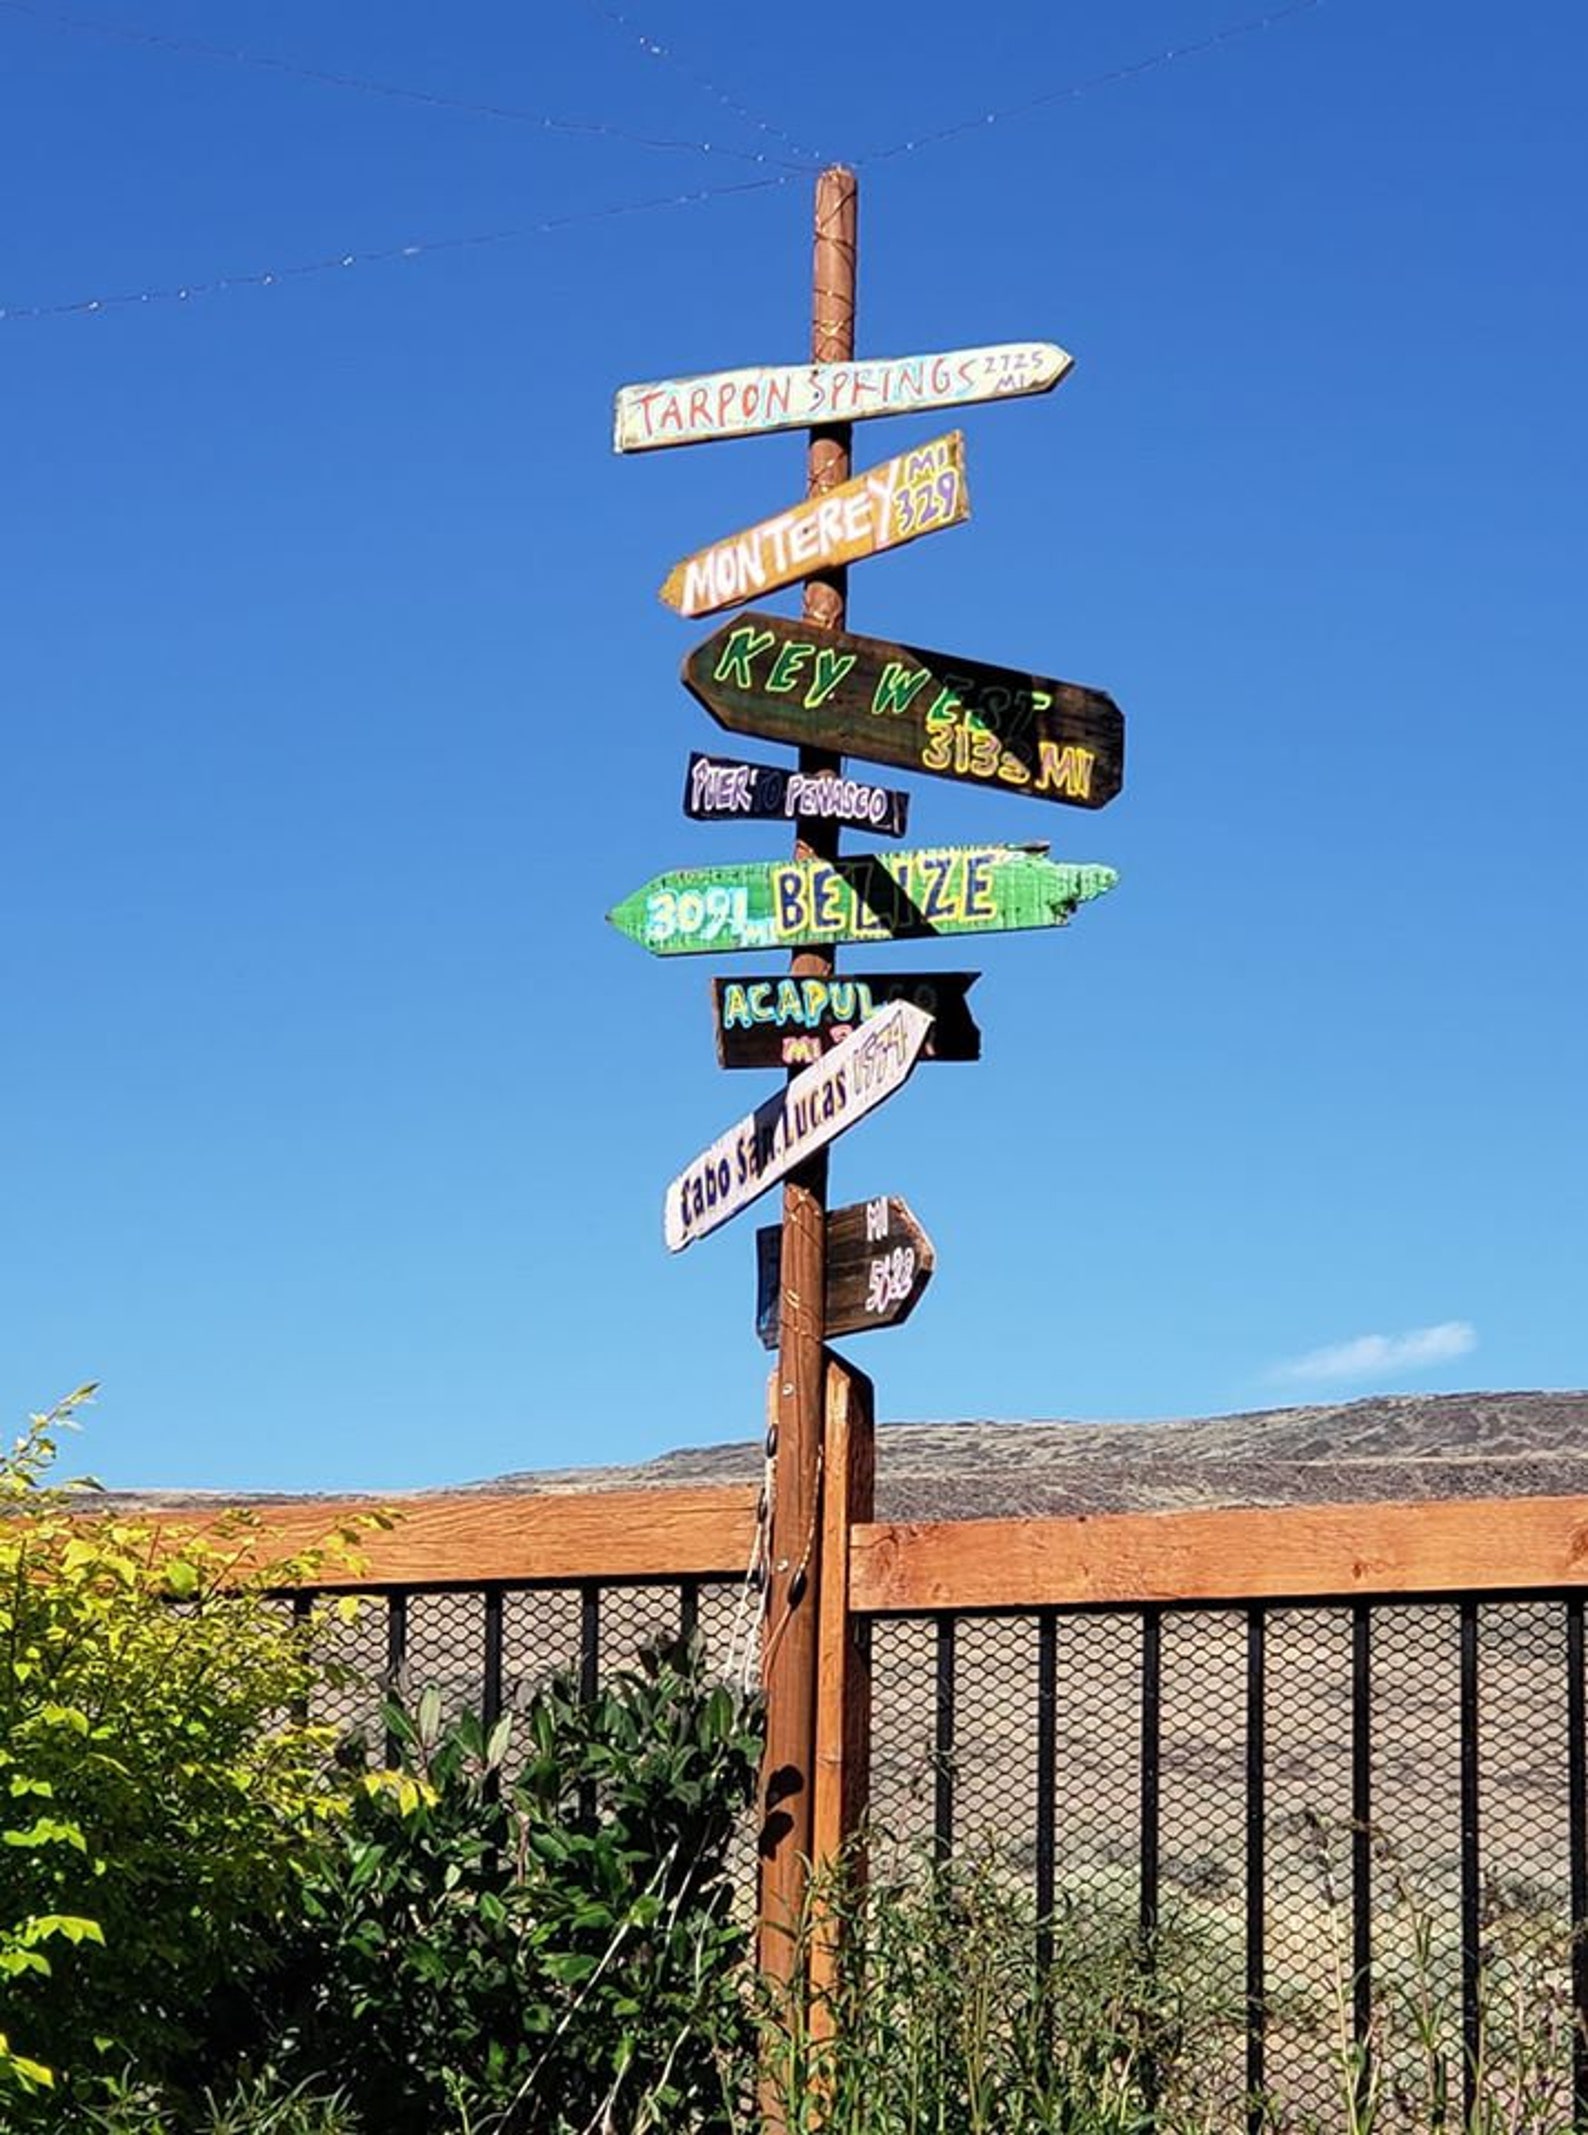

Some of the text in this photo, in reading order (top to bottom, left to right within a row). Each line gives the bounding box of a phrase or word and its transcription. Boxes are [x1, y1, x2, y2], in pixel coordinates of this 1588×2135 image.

[639, 356, 978, 436] TARPON SPRINGS
[895, 465, 957, 535] 329
[906, 441, 948, 485] MI
[681, 456, 901, 617] MONTEREY
[713, 626, 1053, 732] KEY WEST
[771, 851, 998, 937] BELIZE
